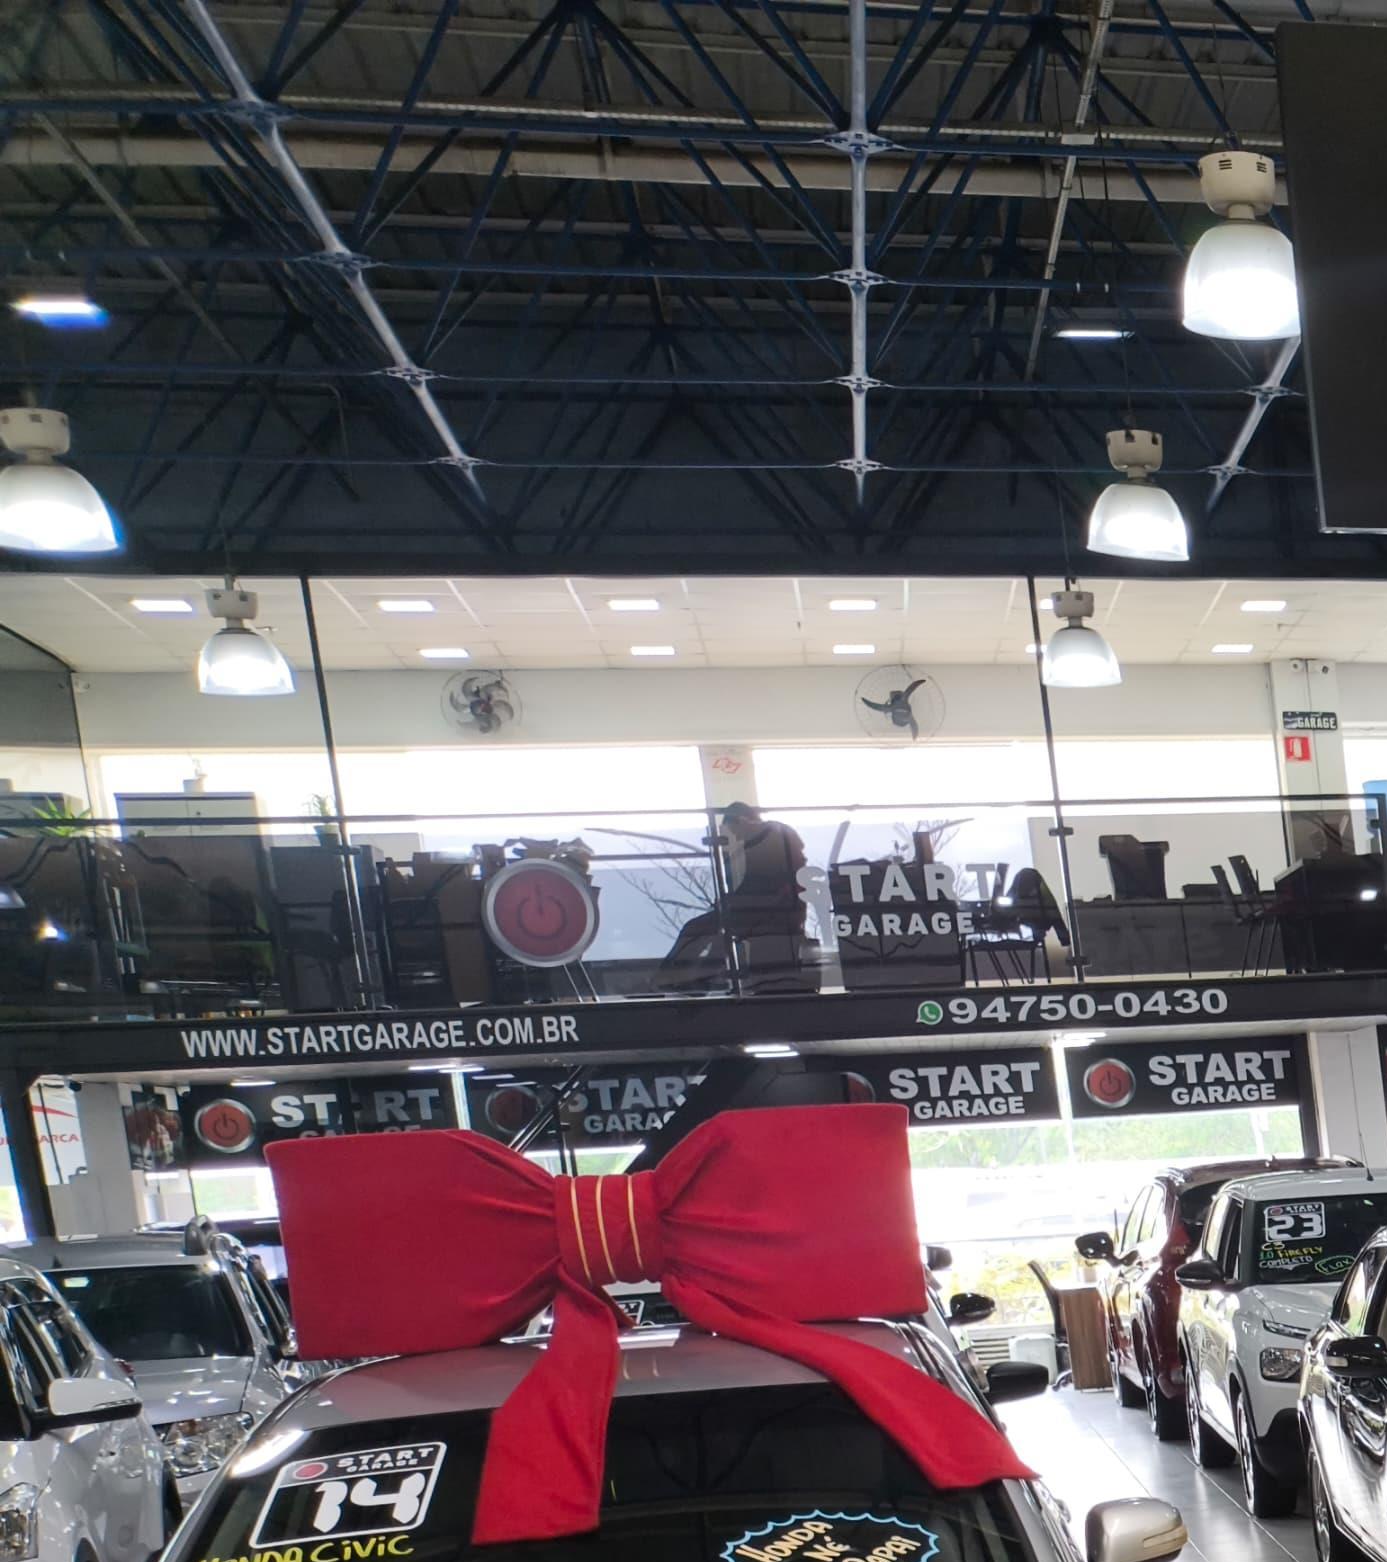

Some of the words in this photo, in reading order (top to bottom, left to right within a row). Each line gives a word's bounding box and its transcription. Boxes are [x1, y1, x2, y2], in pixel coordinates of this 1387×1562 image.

[797, 863, 1009, 902] START
[835, 911, 973, 937] GARAGE
[949, 989, 1228, 1024] 94750-0430
[181, 1016, 579, 1057] WWW.STARTGARAGE.COM.BR
[890, 1062, 1040, 1098] START
[1149, 1050, 1290, 1086] START
[1171, 1082, 1276, 1105] GARAGE
[914, 1096, 1025, 1120] GARAGE
[1268, 1213, 1322, 1240] 23
[1262, 1241, 1285, 1250] C3
[336, 1447, 434, 1468] START
[346, 1458, 418, 1473] GARAGE
[313, 1471, 427, 1533] 14
